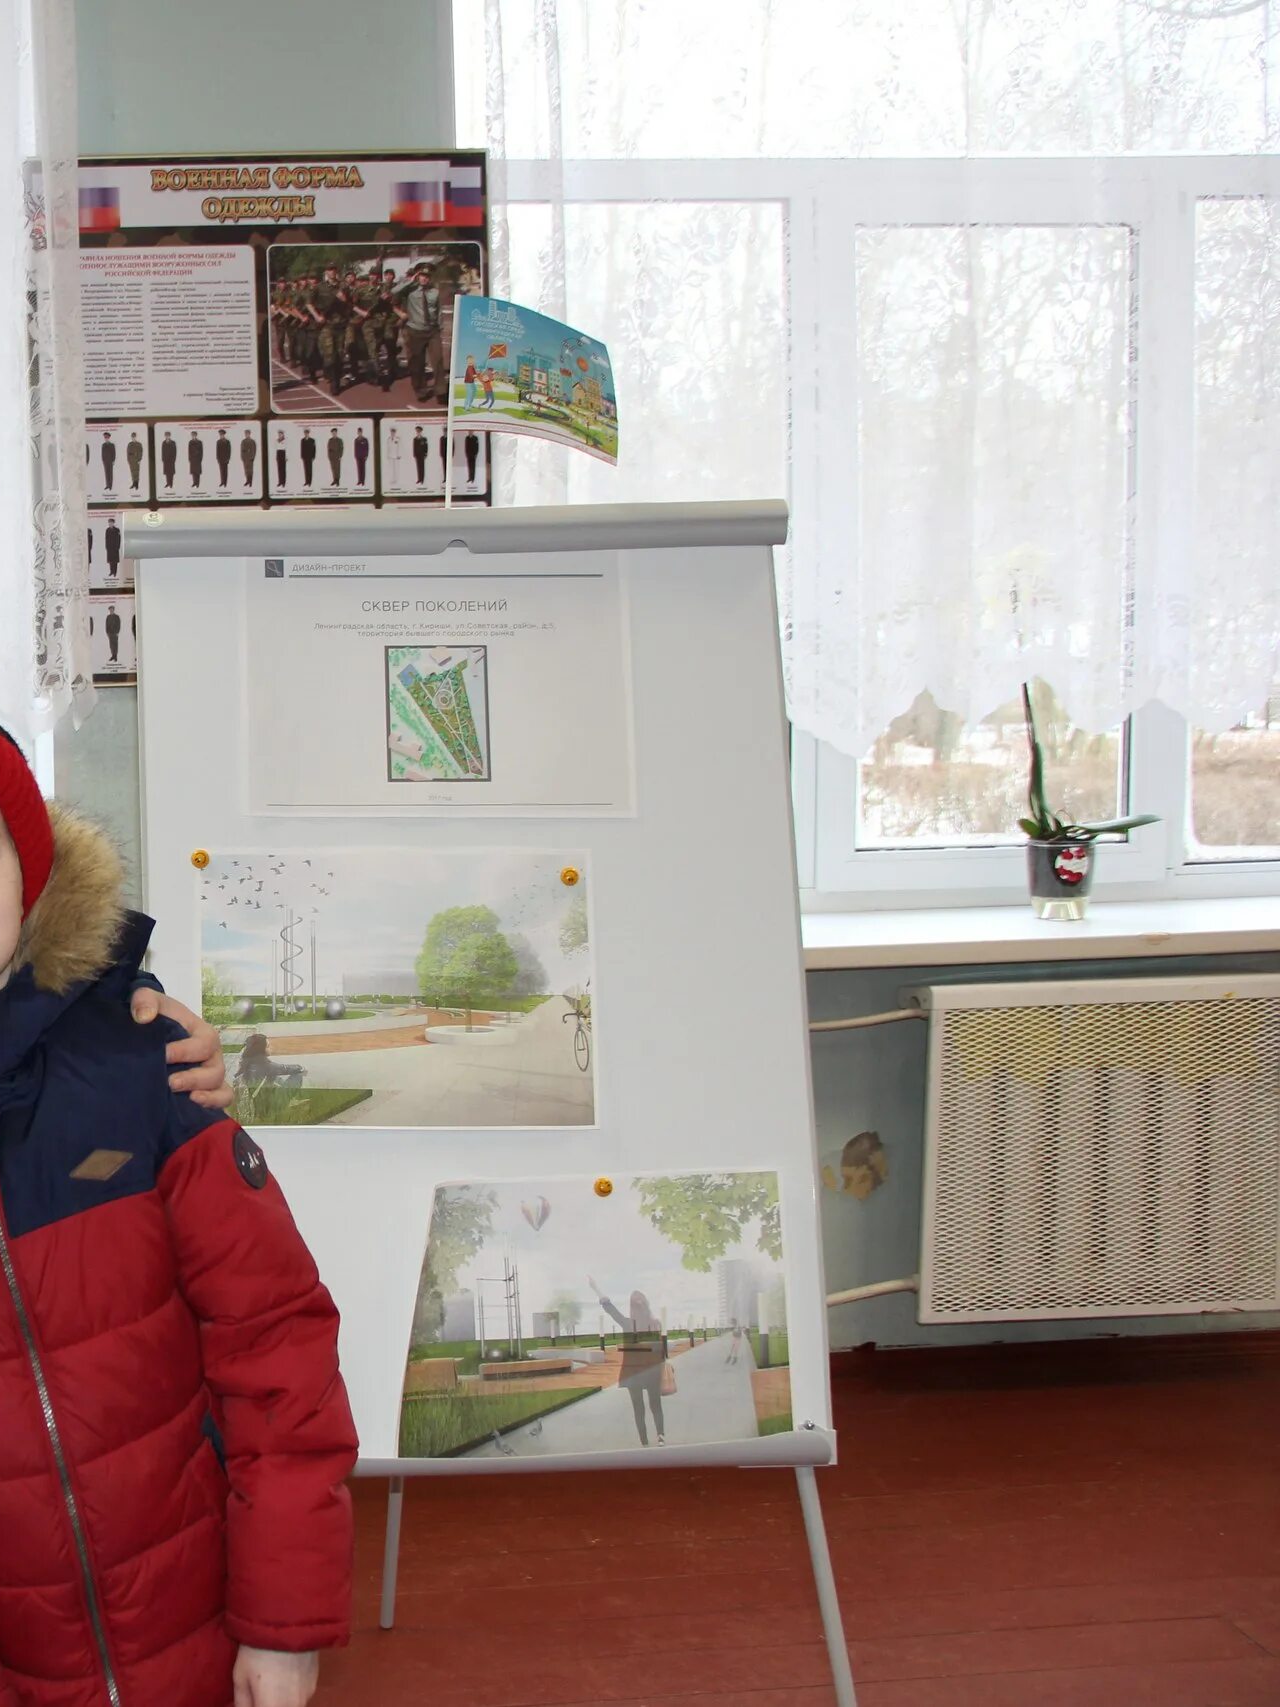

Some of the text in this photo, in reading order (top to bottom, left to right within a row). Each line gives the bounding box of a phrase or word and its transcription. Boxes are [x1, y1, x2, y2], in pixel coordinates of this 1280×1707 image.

[150, 165, 365, 190] ВОЕННАЯ ФОРМА
[201, 195, 316, 223] ОДЕЖДЫ
[142, 252, 177, 260] ВОЕННОЙ
[179, 252, 204, 260] ФОРМЫ
[205, 251, 236, 259] ОДЕЖДЫ
[80, 262, 151, 270] ОЕННОСЛУЖАЩИМИ
[105, 268, 193, 277] РОССИЙСКОЙ ФЕДЕРАЦИИ
[292, 563, 367, 572] ДИЗАЙН-ПРОЕКТ
[361, 598, 508, 612] СКВЕР ПОКОЛЕНИЙ
[314, 623, 374, 631] Ленинградская
[405, 630, 441, 638] бывшего
[442, 630, 489, 638] городского
